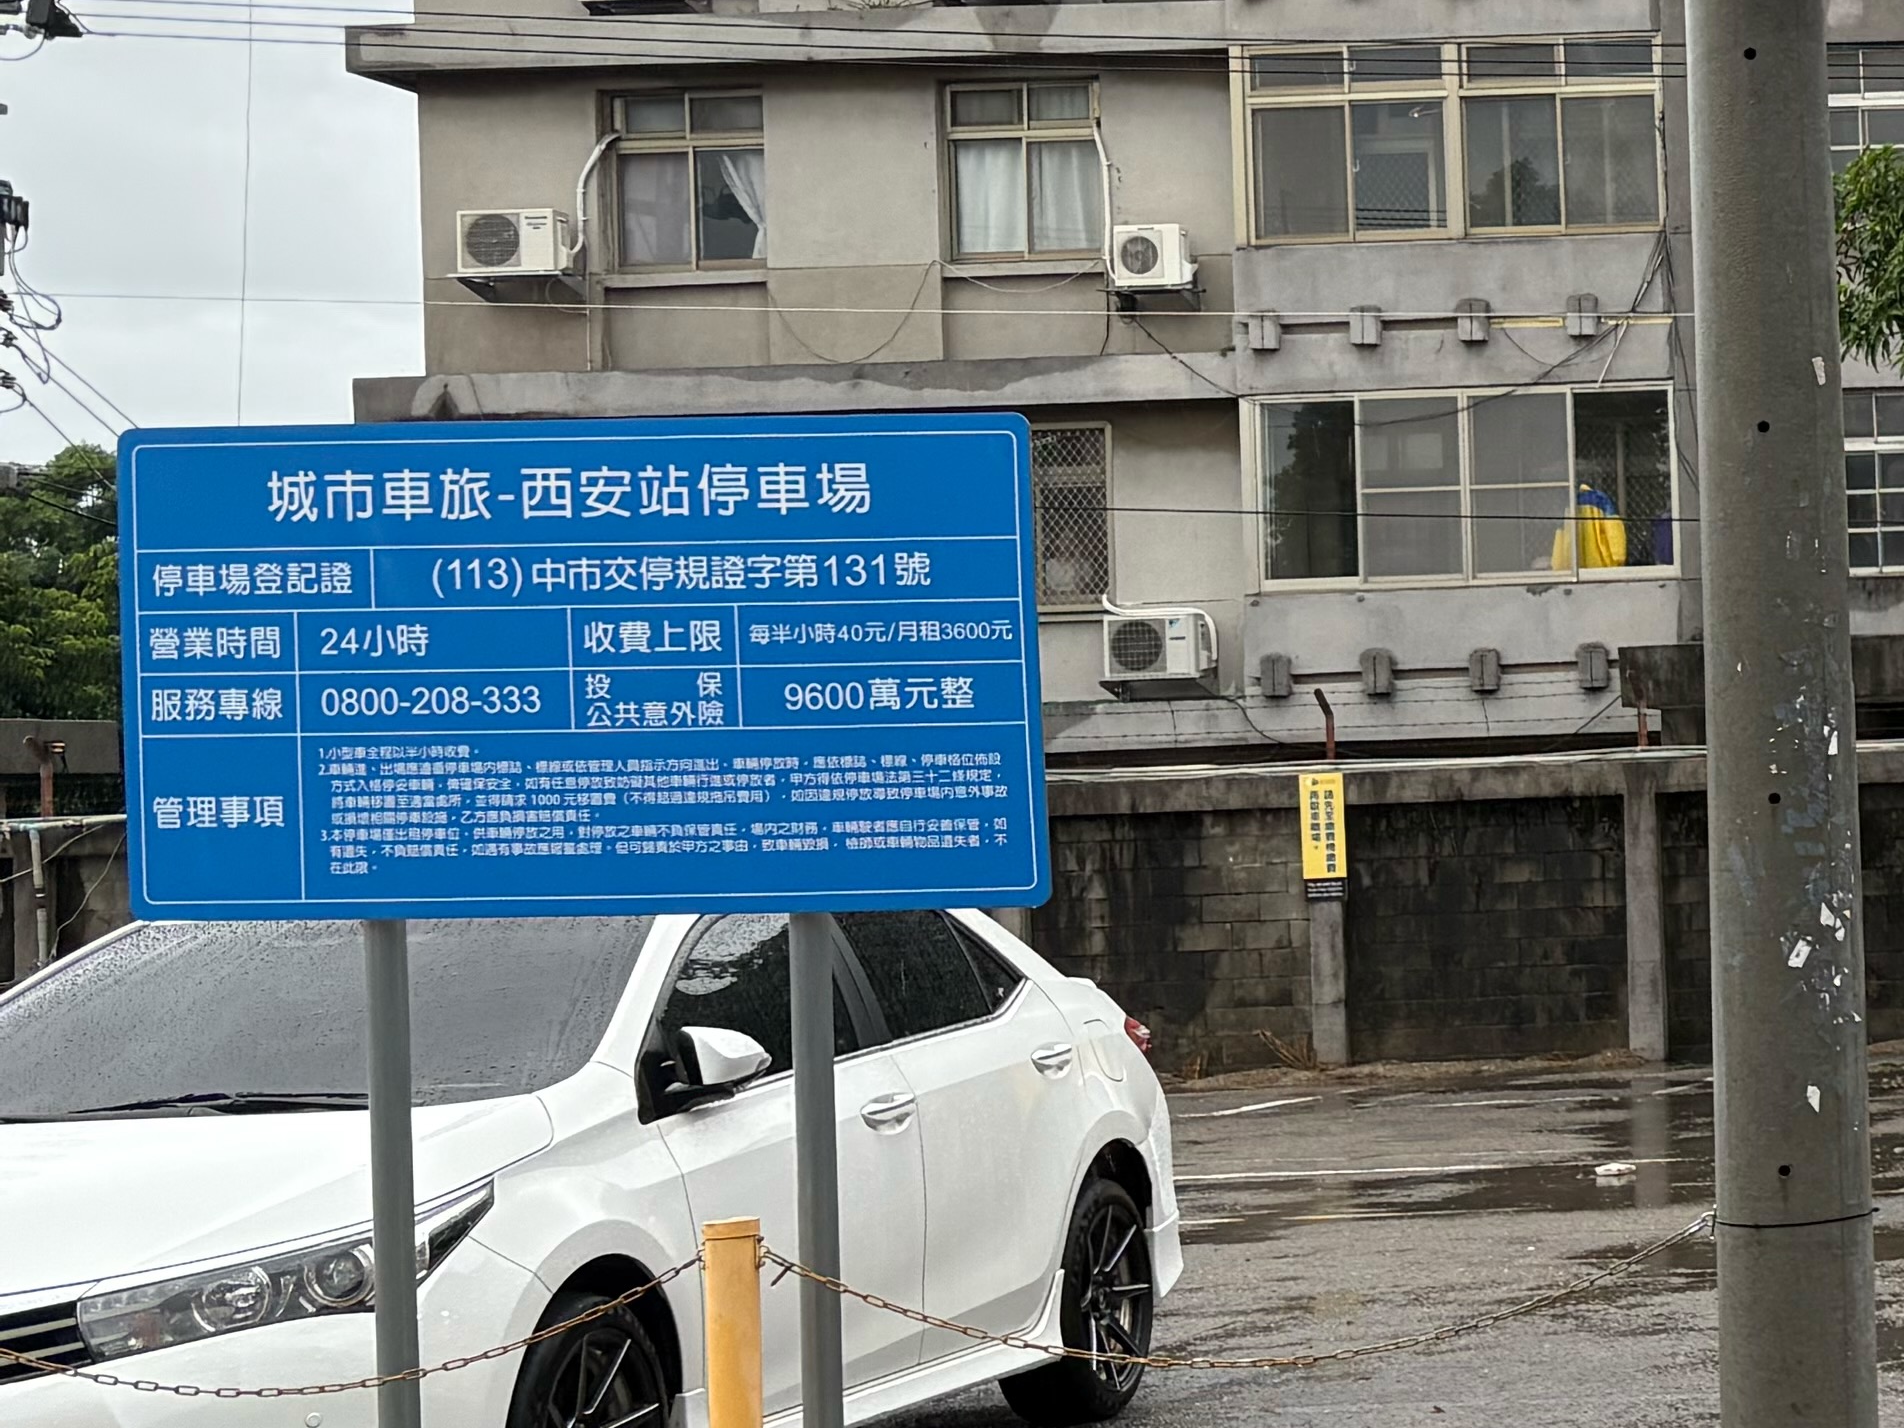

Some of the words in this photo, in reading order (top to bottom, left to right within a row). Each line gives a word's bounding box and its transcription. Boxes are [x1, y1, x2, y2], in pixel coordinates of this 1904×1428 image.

[268, 463, 870, 521] 城市車旅-西安站停車場
[153, 563, 352, 596] 停車場登記證
[150, 627, 280, 659] 營業時間
[321, 624, 428, 656] 24小時
[584, 621, 721, 653] 收費上限
[750, 620, 1012, 644] 每半小時40元/月租3600元
[152, 688, 282, 721] 服務專線
[322, 686, 540, 715] 0800-208-333
[785, 677, 974, 710] 9600萬元整
[588, 701, 723, 726] 公共意外險
[154, 796, 284, 828] 管理事項
